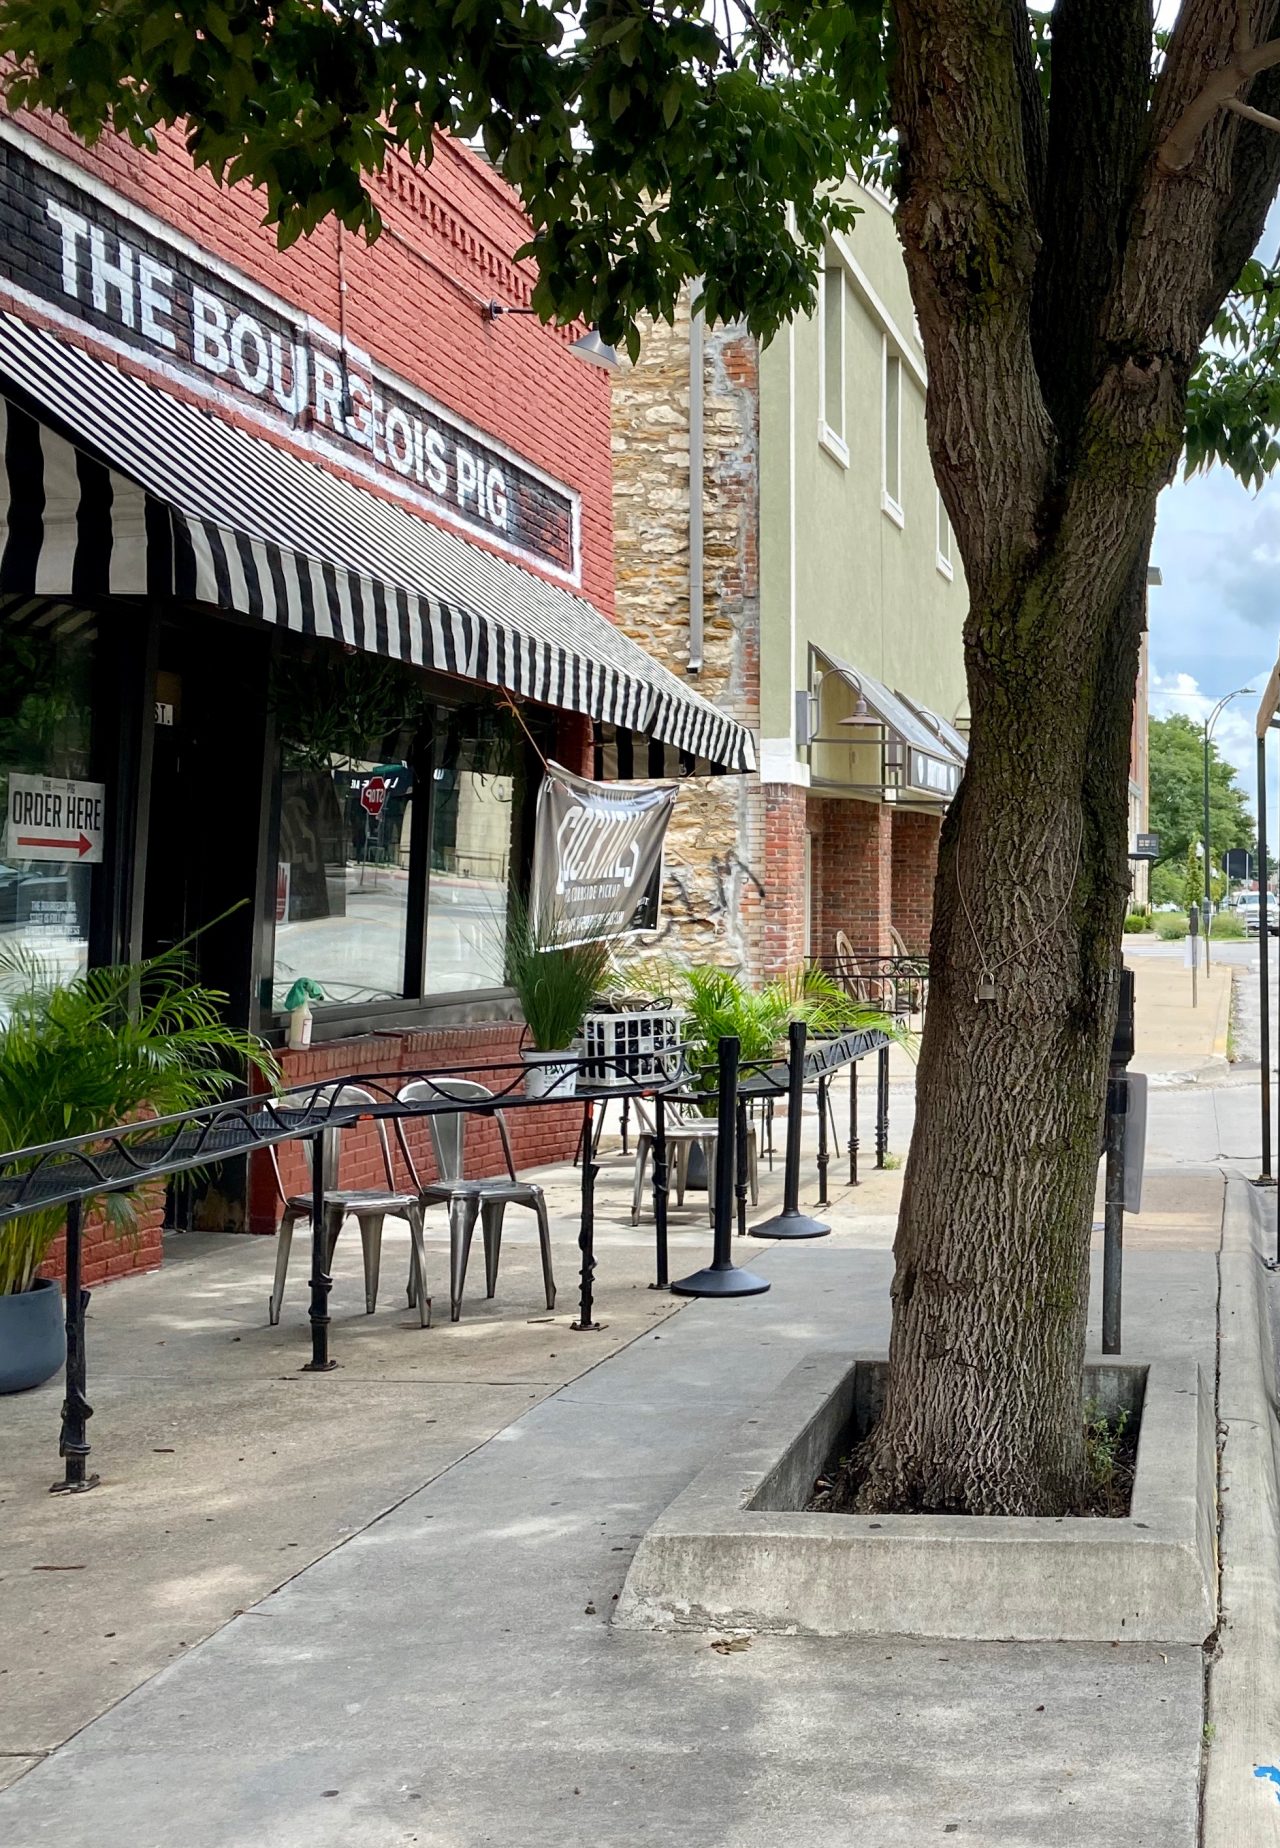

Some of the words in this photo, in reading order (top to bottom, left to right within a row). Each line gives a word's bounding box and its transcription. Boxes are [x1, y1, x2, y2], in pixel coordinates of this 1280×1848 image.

[46, 198, 177, 352] THE
[191, 284, 448, 496] BOURGEOIS
[455, 444, 509, 532] PIG
[12, 790, 62, 828] ORDER
[66, 795, 102, 831] HERE
